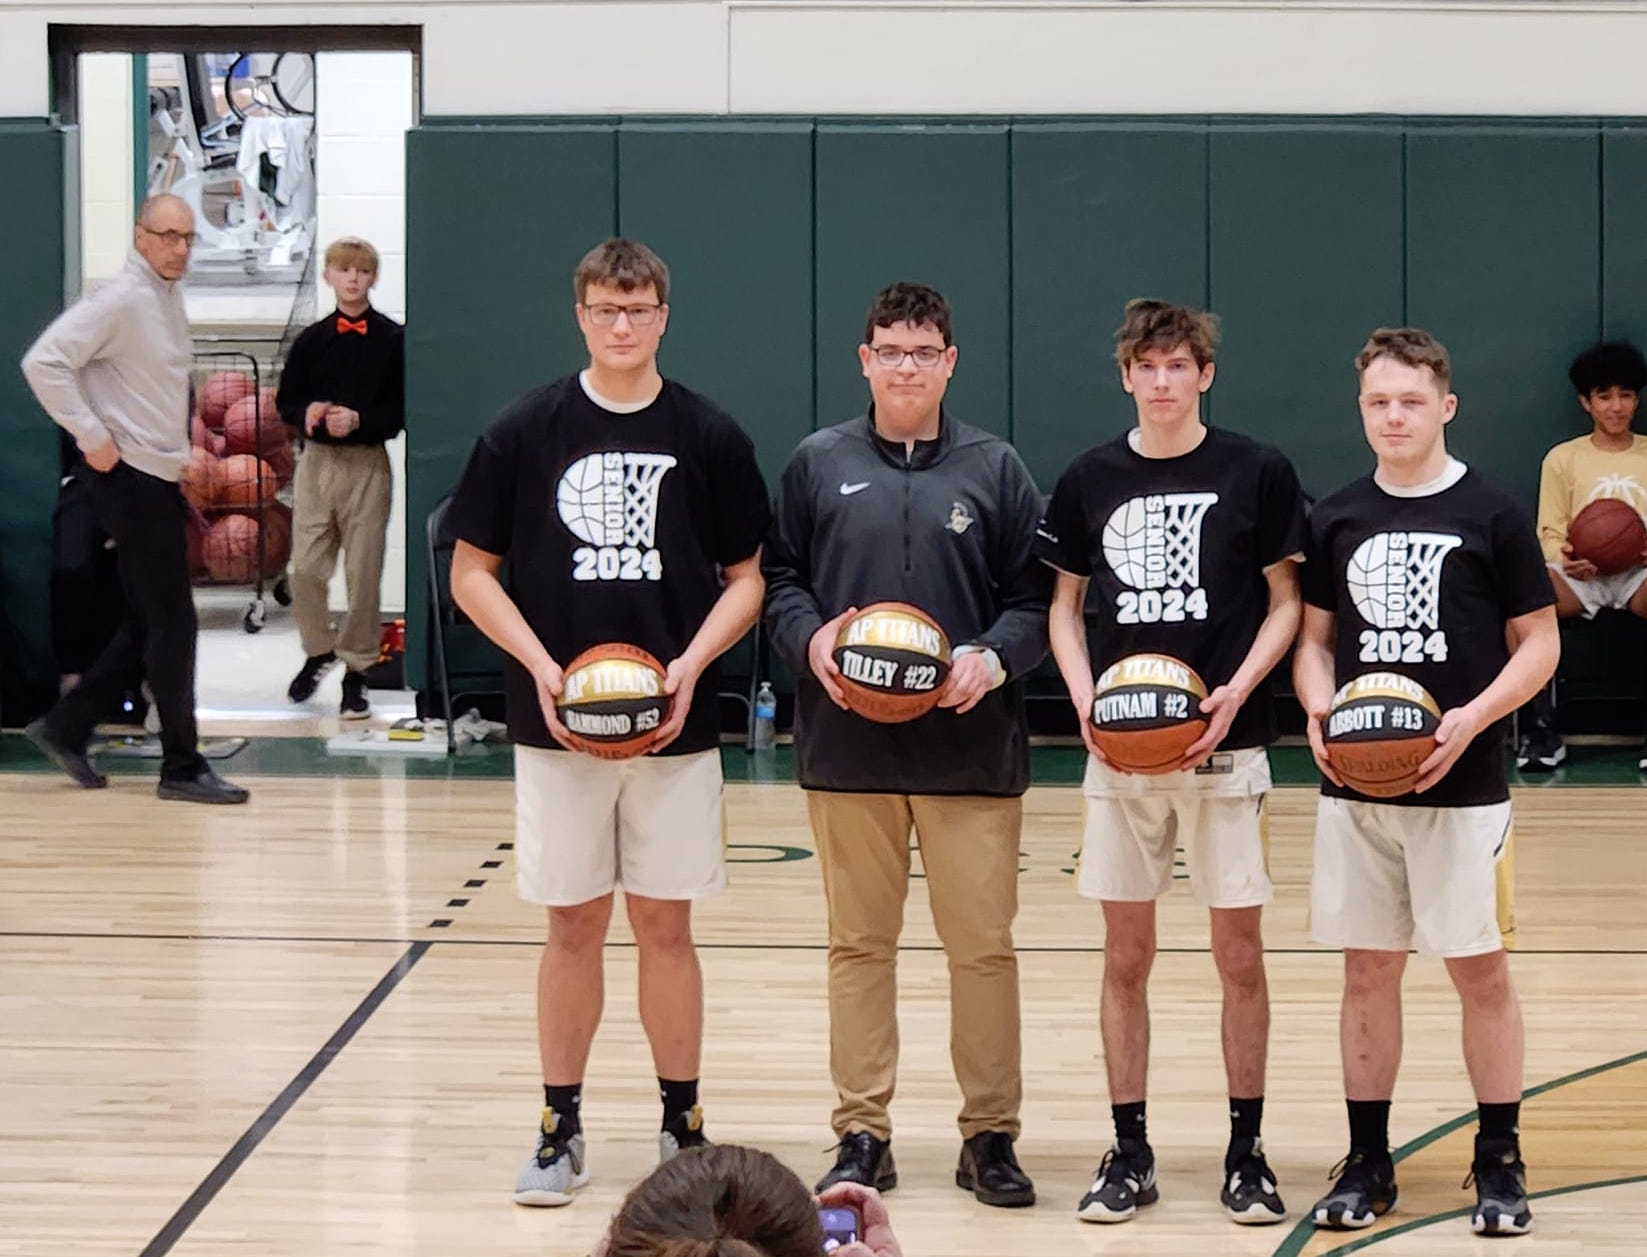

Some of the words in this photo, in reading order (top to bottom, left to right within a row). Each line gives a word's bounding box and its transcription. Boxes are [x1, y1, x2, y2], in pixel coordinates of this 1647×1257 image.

[603, 452, 625, 547] SENIOR
[1145, 495, 1167, 589] SENIOR
[572, 547, 663, 581] 2024
[1386, 532, 1408, 628] SENIOR
[1116, 587, 1209, 624] 2024
[845, 619, 873, 646] AP
[878, 619, 940, 657] TITANS
[1358, 630, 1449, 663] 2024
[564, 670, 588, 702] AP
[591, 666, 659, 697] TITANS
[842, 650, 899, 687] TILLEY
[903, 664, 937, 690] #22
[1123, 659, 1191, 689] TITANS
[1356, 672, 1424, 702] TITANS
[1094, 692, 1158, 725] PUTNAM
[1164, 693, 1189, 719] #2
[1328, 704, 1386, 737] ABBOTT
[1390, 705, 1424, 730] #13
